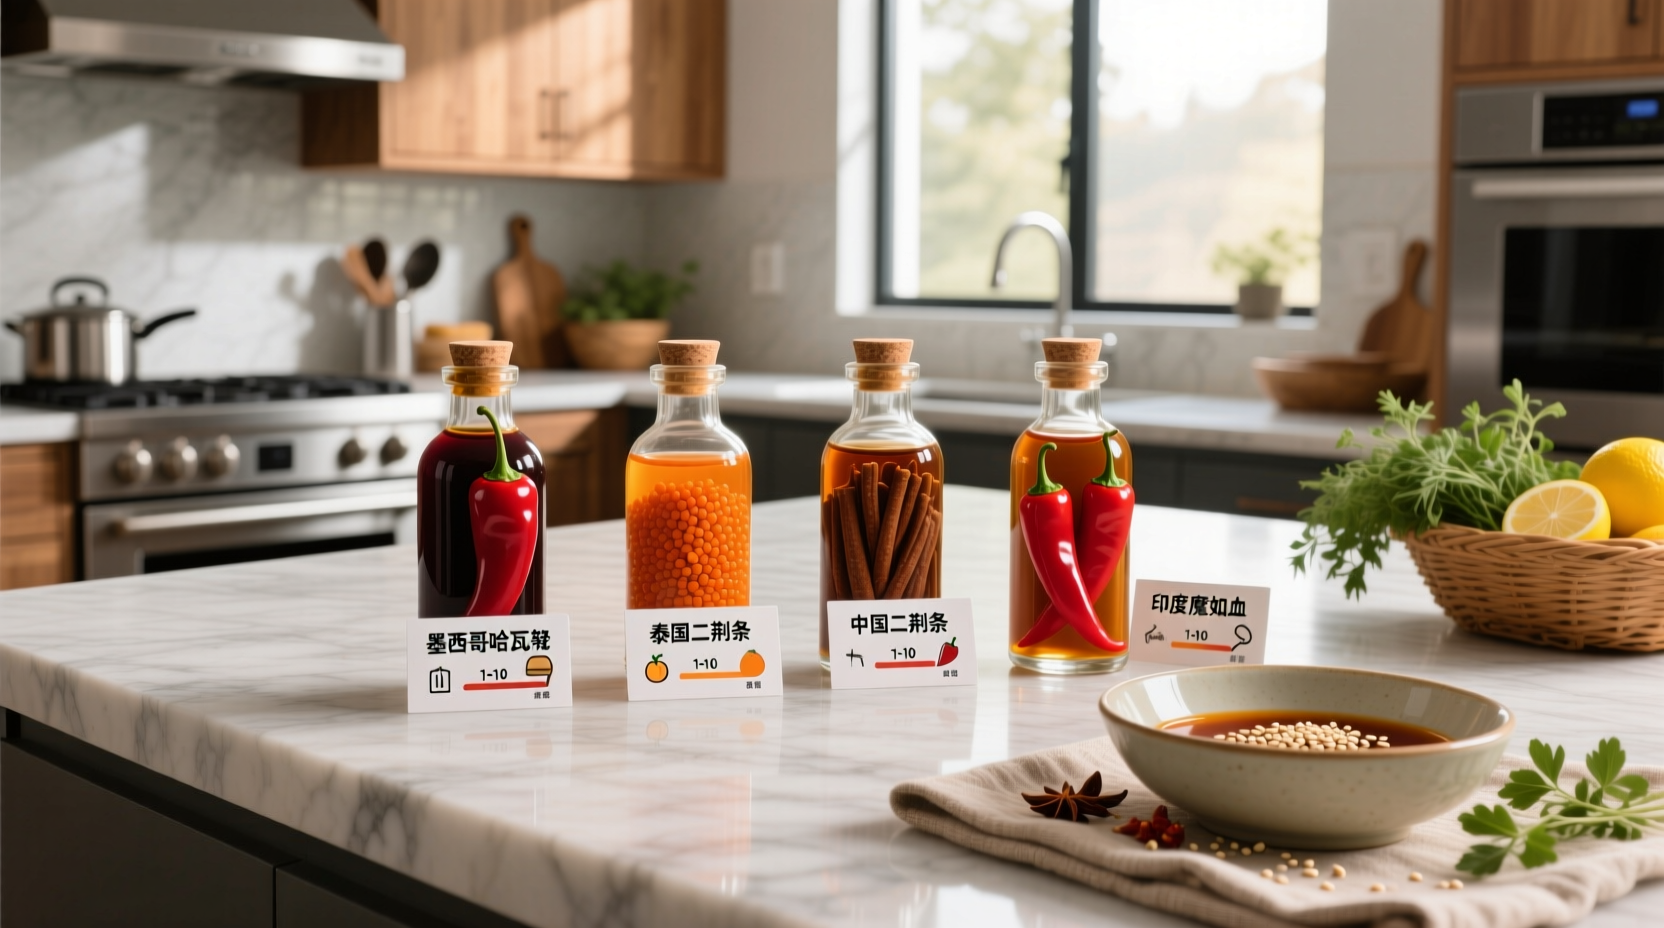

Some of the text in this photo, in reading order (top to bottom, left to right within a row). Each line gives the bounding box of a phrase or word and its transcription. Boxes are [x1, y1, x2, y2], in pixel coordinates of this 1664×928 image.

[851, 612, 948, 635] 中国二荆条
[650, 620, 750, 644] 泰国二荆条
[1185, 629, 1208, 641] 1-10
[891, 647, 916, 660] 1-10
[693, 658, 718, 669] 1-10
[480, 669, 507, 681] 1-10
